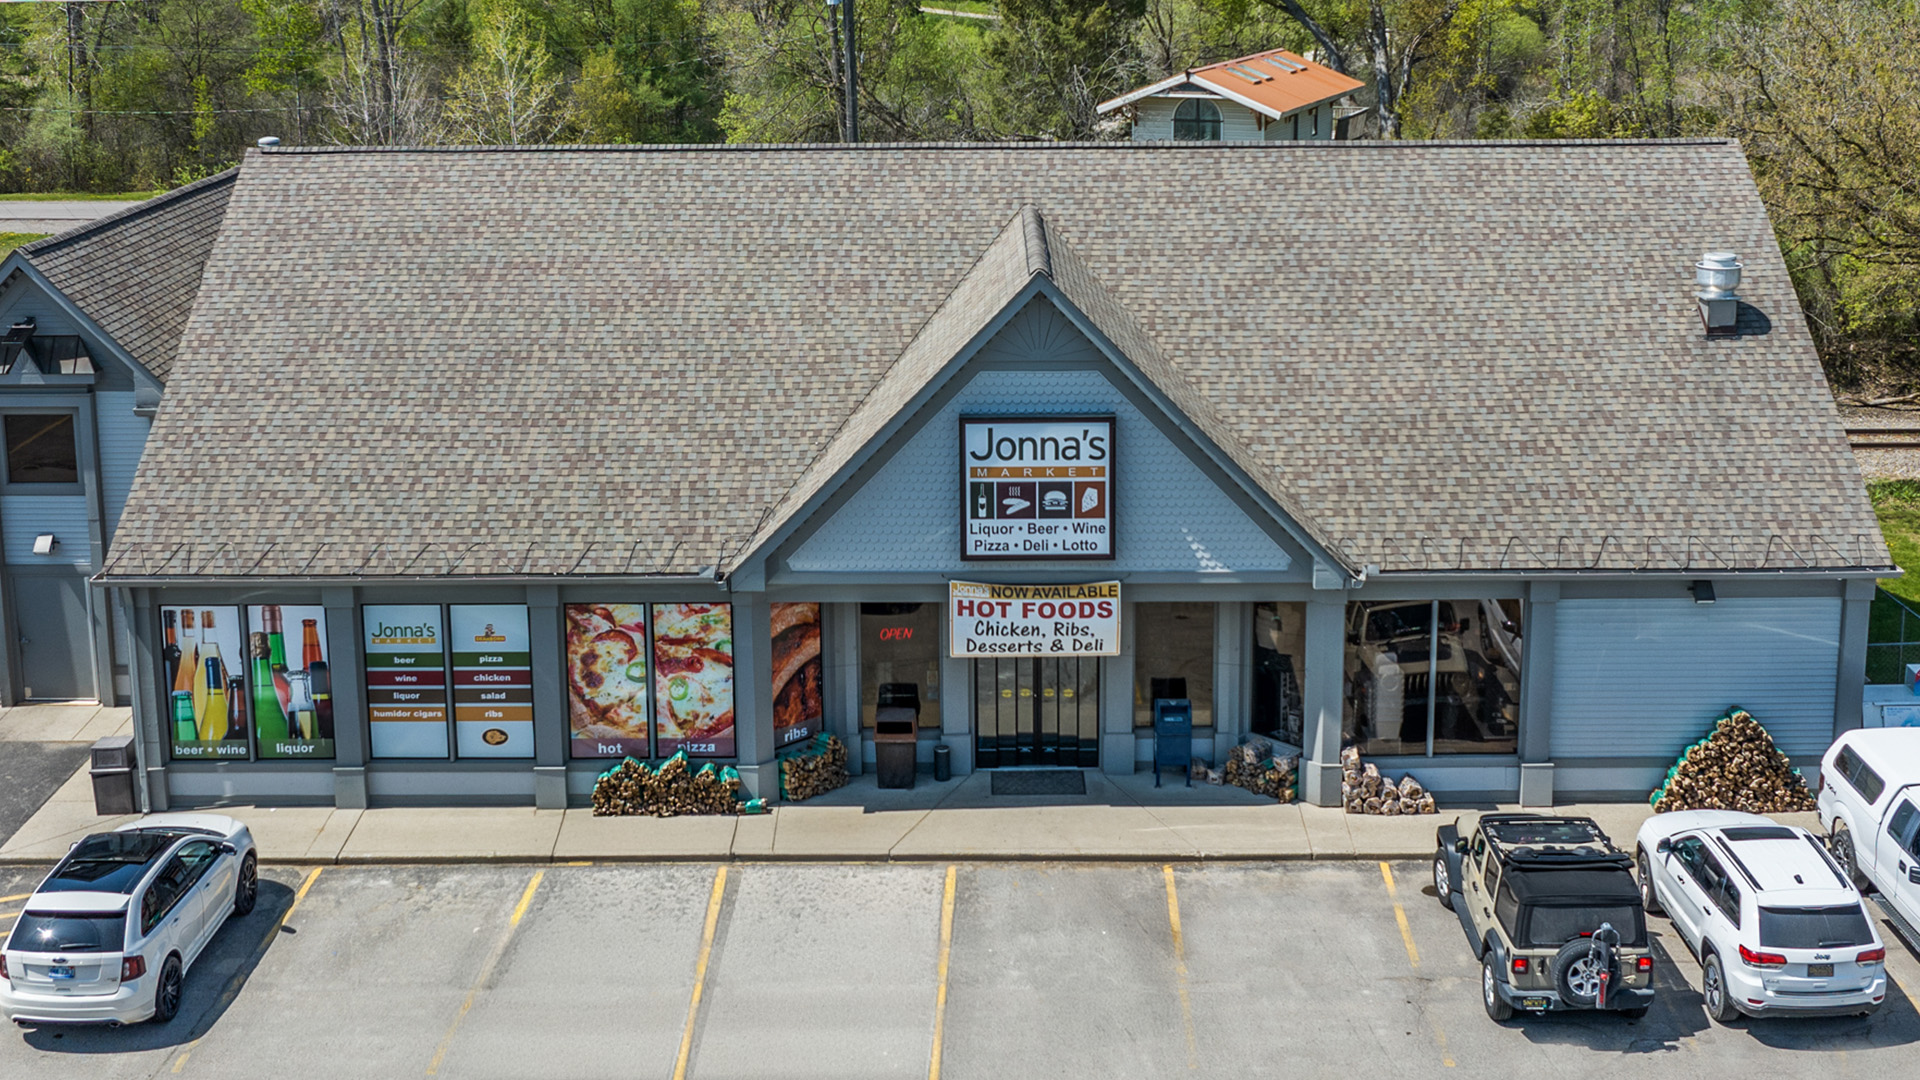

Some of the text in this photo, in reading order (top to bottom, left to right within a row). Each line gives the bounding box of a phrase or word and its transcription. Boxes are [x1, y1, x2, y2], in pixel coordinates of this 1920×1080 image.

[969, 427, 1106, 461] Jonna's
[976, 467, 1099, 477] MARKET
[970, 522, 1106, 537] Liquor Beer Wine
[974, 539, 1098, 551] Pizza Deli Lotto
[991, 585, 1118, 598] NOW AVAILABLE
[957, 600, 1113, 619] HOT FOODS
[371, 621, 436, 638] Jonna's
[879, 627, 914, 641] OPEN
[974, 620, 1095, 638] Chicken, Ribs,
[966, 638, 1104, 653] Desserts & Deli
[393, 656, 416, 664] beer
[479, 655, 503, 664] pizza
[394, 674, 417, 682] wine
[473, 674, 511, 682] chicken
[393, 692, 420, 700] liquor
[480, 692, 506, 700] salad
[413, 710, 442, 718] cigars
[485, 710, 503, 718] ribs
[784, 725, 808, 743] ribs
[175, 745, 247, 755] beer wine
[276, 743, 314, 755] liquor
[598, 742, 622, 754] hot
